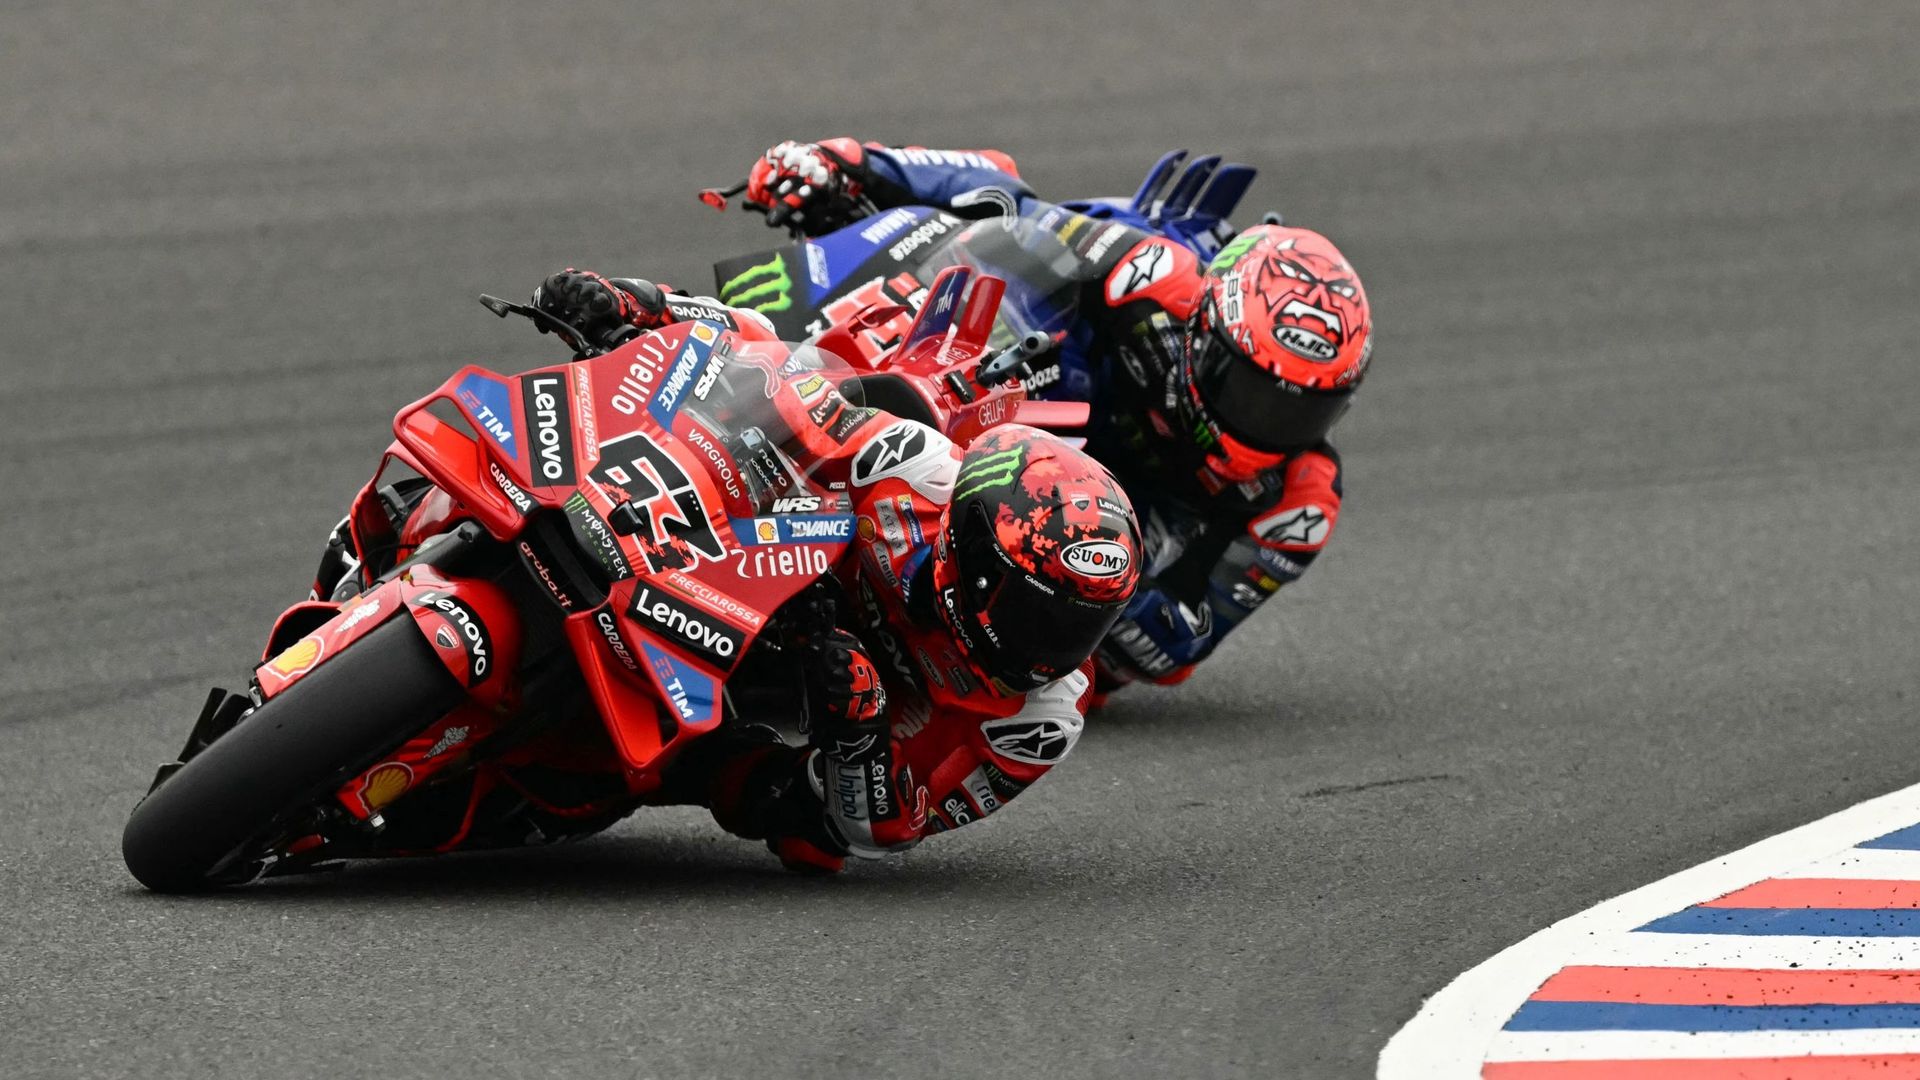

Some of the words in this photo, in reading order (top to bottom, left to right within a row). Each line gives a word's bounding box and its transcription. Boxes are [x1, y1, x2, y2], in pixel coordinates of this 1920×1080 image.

[860, 208, 917, 244] YAMAHA
[888, 218, 947, 262] Roboze
[671, 305, 731, 328] Lenovo
[1281, 329, 1331, 356] HJC
[611, 342, 664, 417] riello
[657, 342, 699, 413] ADVANCE
[693, 355, 725, 402] WRS
[476, 405, 513, 444] TIM
[532, 377, 564, 480] Lenovo
[576, 365, 599, 463] FRECCIAROSSA
[837, 411, 867, 438] MONSTER
[490, 462, 532, 512] CARRERA
[687, 428, 741, 500] VARGROUP
[771, 496, 822, 513] WRS
[581, 508, 628, 579] MONSTER
[754, 545, 828, 578] riello
[1071, 546, 1126, 572] SUOMY
[519, 541, 575, 609] aruba.it
[668, 571, 761, 626] FRECCIAROSSA
[1024, 574, 1055, 596] CARRERA
[418, 593, 487, 677] Lenovo
[597, 612, 638, 671] CARRERA
[635, 587, 735, 658] Lenovo
[944, 588, 974, 649] Lenovo
[667, 677, 695, 719] TIM
[837, 763, 867, 821] Unipol
